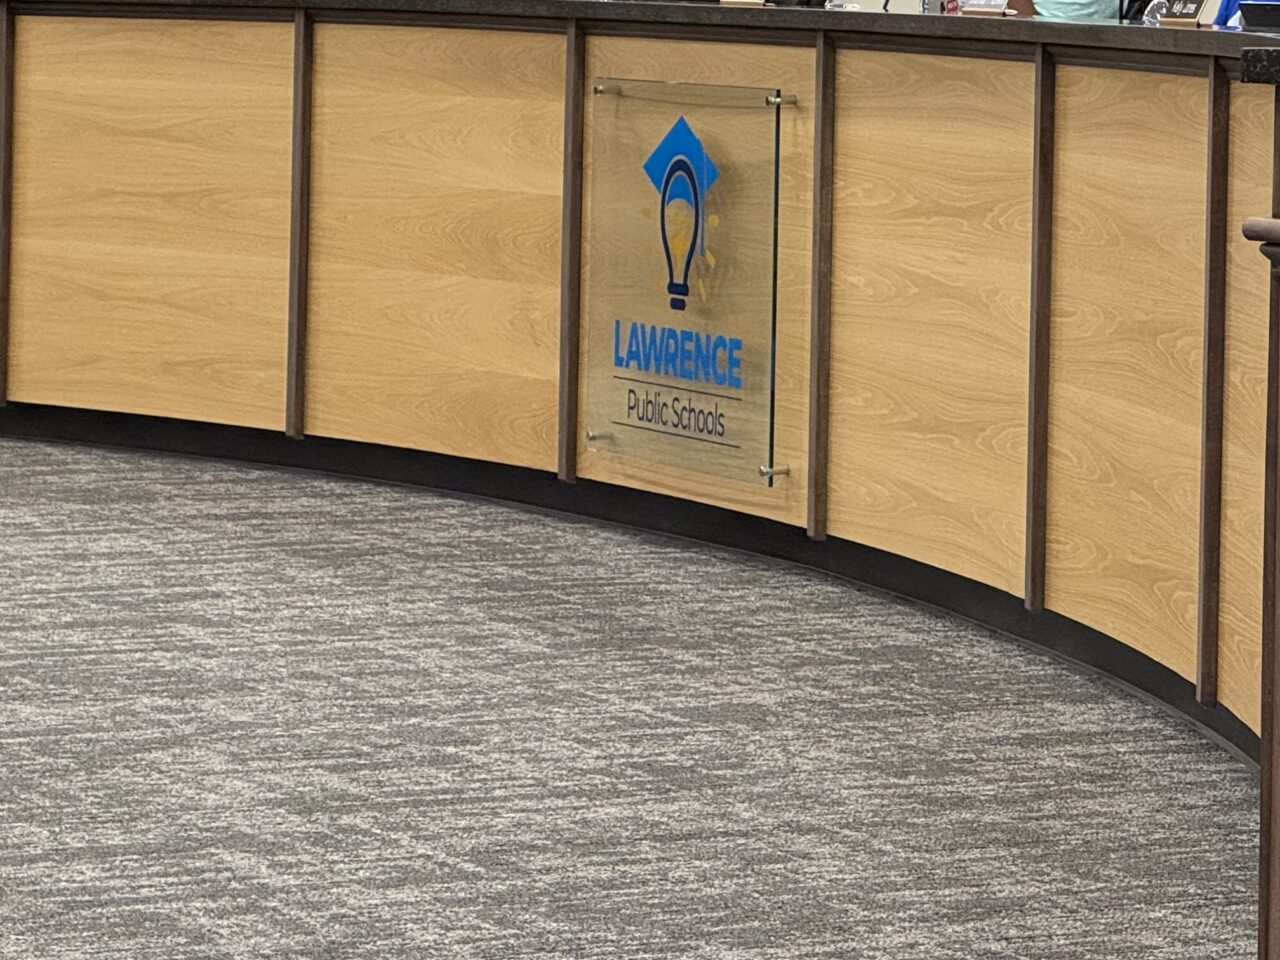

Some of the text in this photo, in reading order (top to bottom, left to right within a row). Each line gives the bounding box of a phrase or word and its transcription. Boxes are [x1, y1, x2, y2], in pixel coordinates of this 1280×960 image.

[614, 319, 743, 389] LAWRENCE
[627, 388, 725, 437] Public Schools
